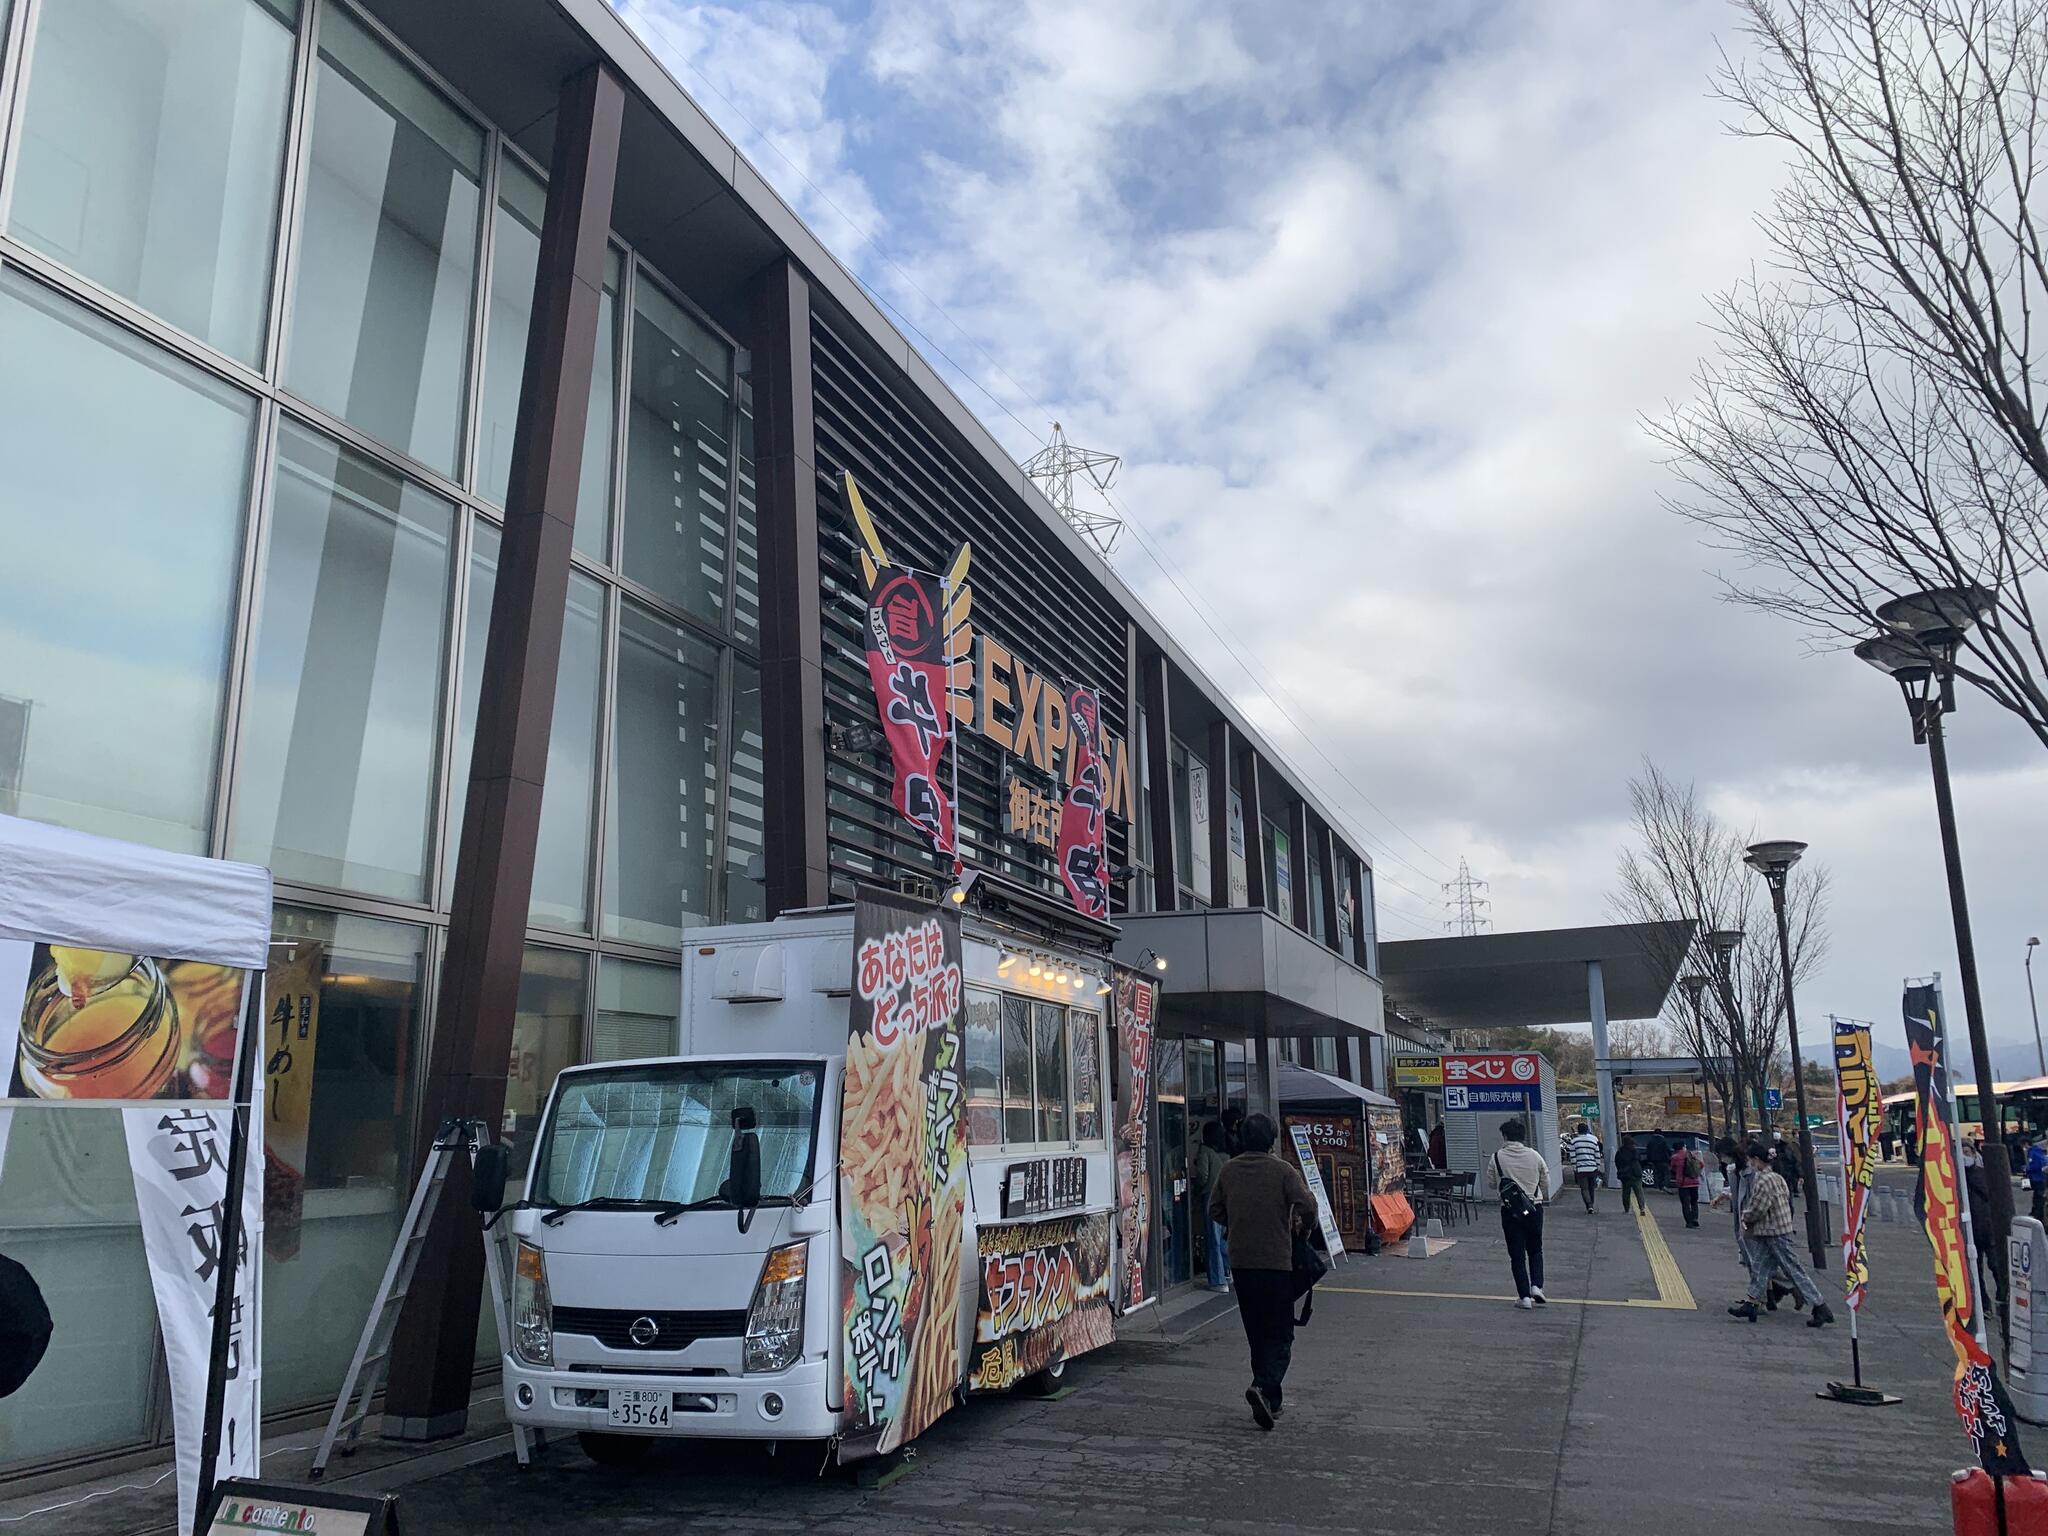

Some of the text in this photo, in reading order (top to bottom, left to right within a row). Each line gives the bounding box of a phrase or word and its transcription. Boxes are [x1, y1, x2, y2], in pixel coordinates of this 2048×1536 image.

[860, 920, 944, 997] あなたは
[266, 993, 295, 1122] 牛めし
[1445, 1060, 1505, 1080] 宝くじ
[1468, 1092, 1522, 1103] 自動販売機
[924, 1069, 940, 1167] ポテト
[930, 1032, 960, 1190] フライド
[863, 1243, 902, 1379] ロング
[850, 1310, 885, 1427] ポテト
[622, 1403, 668, 1426] 35-64
[242, 1504, 316, 1531] contento
